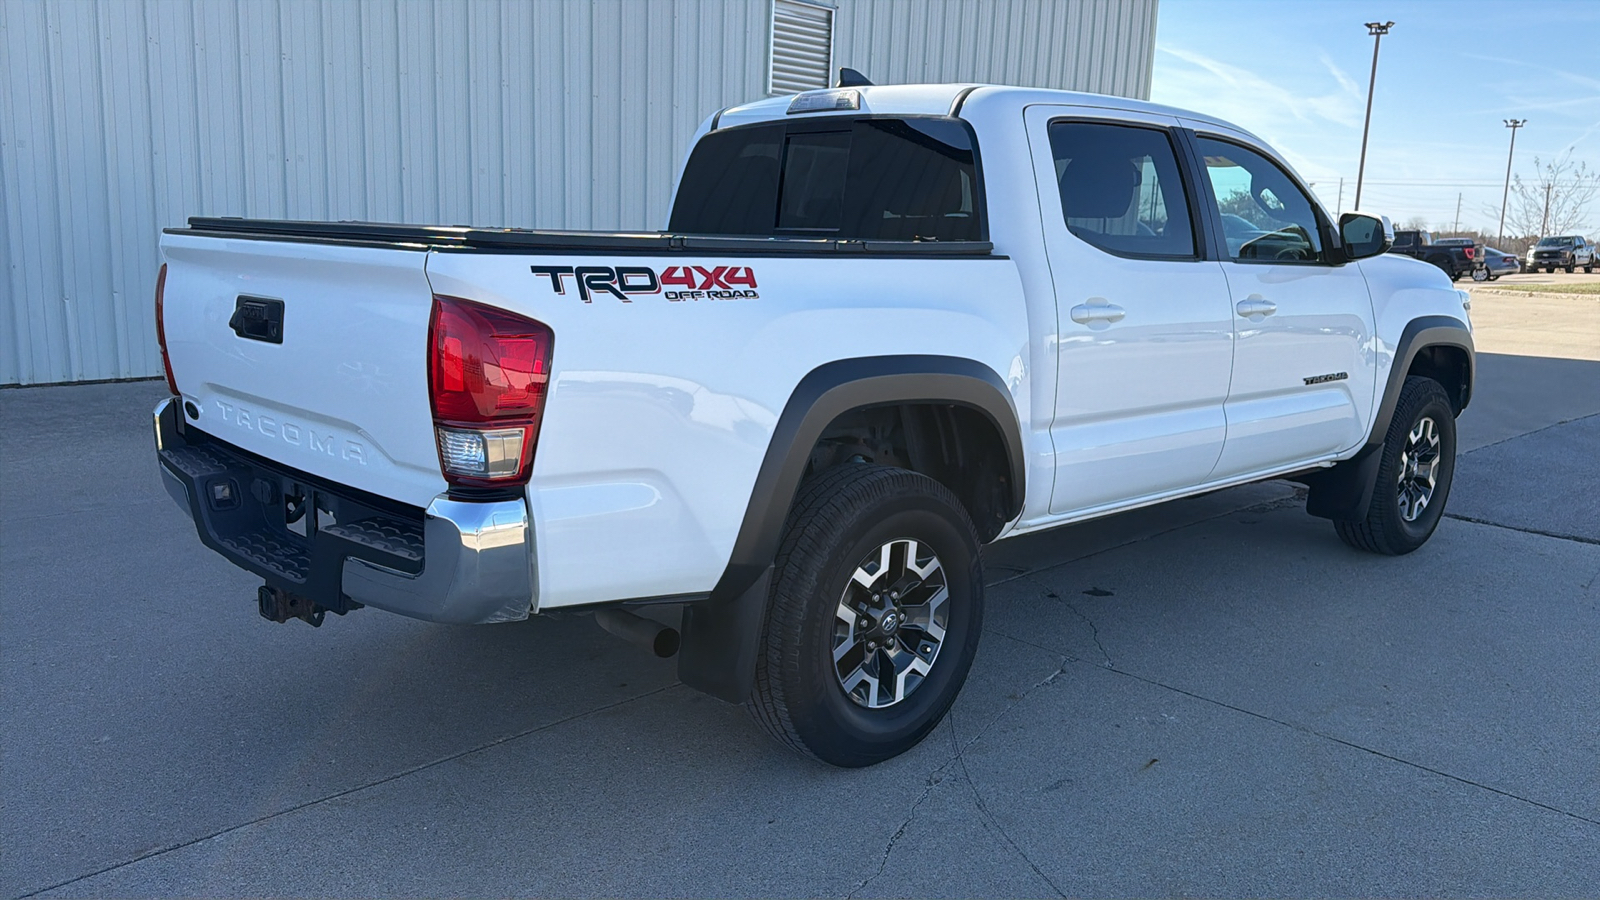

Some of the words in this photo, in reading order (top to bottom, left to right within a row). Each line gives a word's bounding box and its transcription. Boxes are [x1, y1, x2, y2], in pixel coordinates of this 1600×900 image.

[664, 290, 703, 301] OFF
[707, 290, 759, 300] ROAD
[1303, 371, 1348, 385] TACOMA
[216, 401, 368, 466] TACOMA
